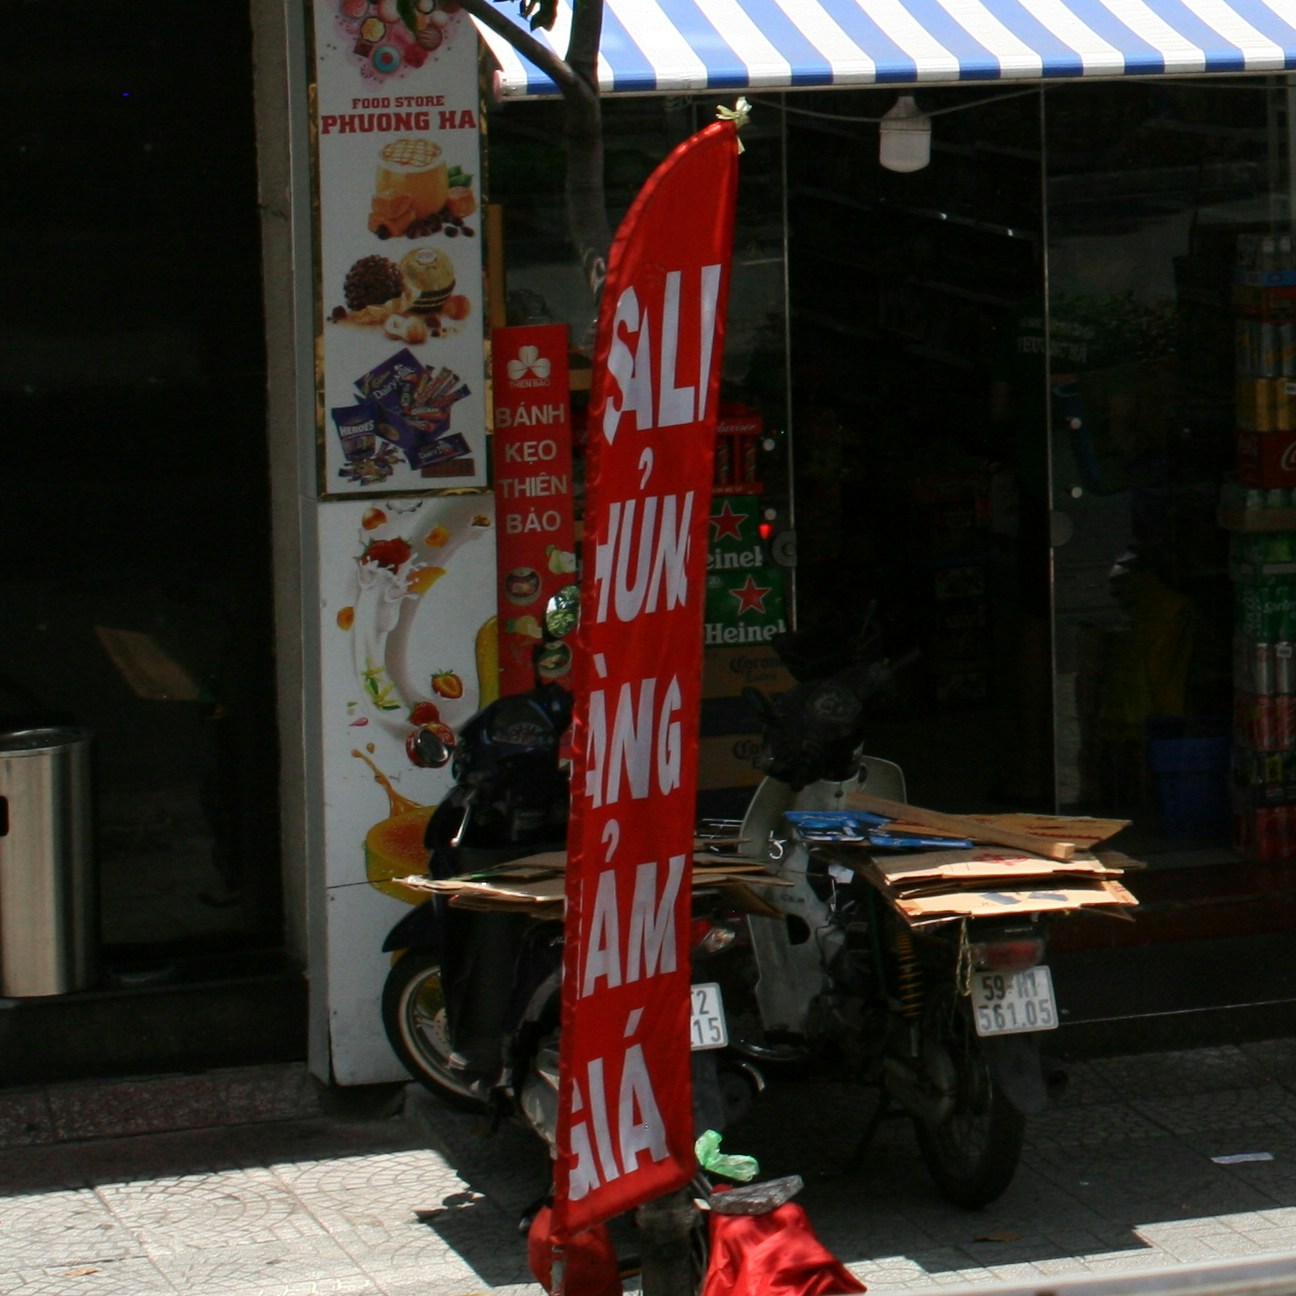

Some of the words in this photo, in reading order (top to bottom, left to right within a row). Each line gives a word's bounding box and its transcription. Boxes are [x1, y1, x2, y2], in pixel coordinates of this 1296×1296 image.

[352, 97, 390, 109] FOOD
[394, 95, 444, 108] STORE
[321, 112, 430, 134] PHUONG
[439, 110, 477, 130] HA
[496, 401, 565, 427] BÁNH
[339, 420, 375, 436] HEROES
[505, 440, 557, 464] KẸO
[499, 472, 568, 498] THIÊN
[506, 507, 561, 534] BẢO
